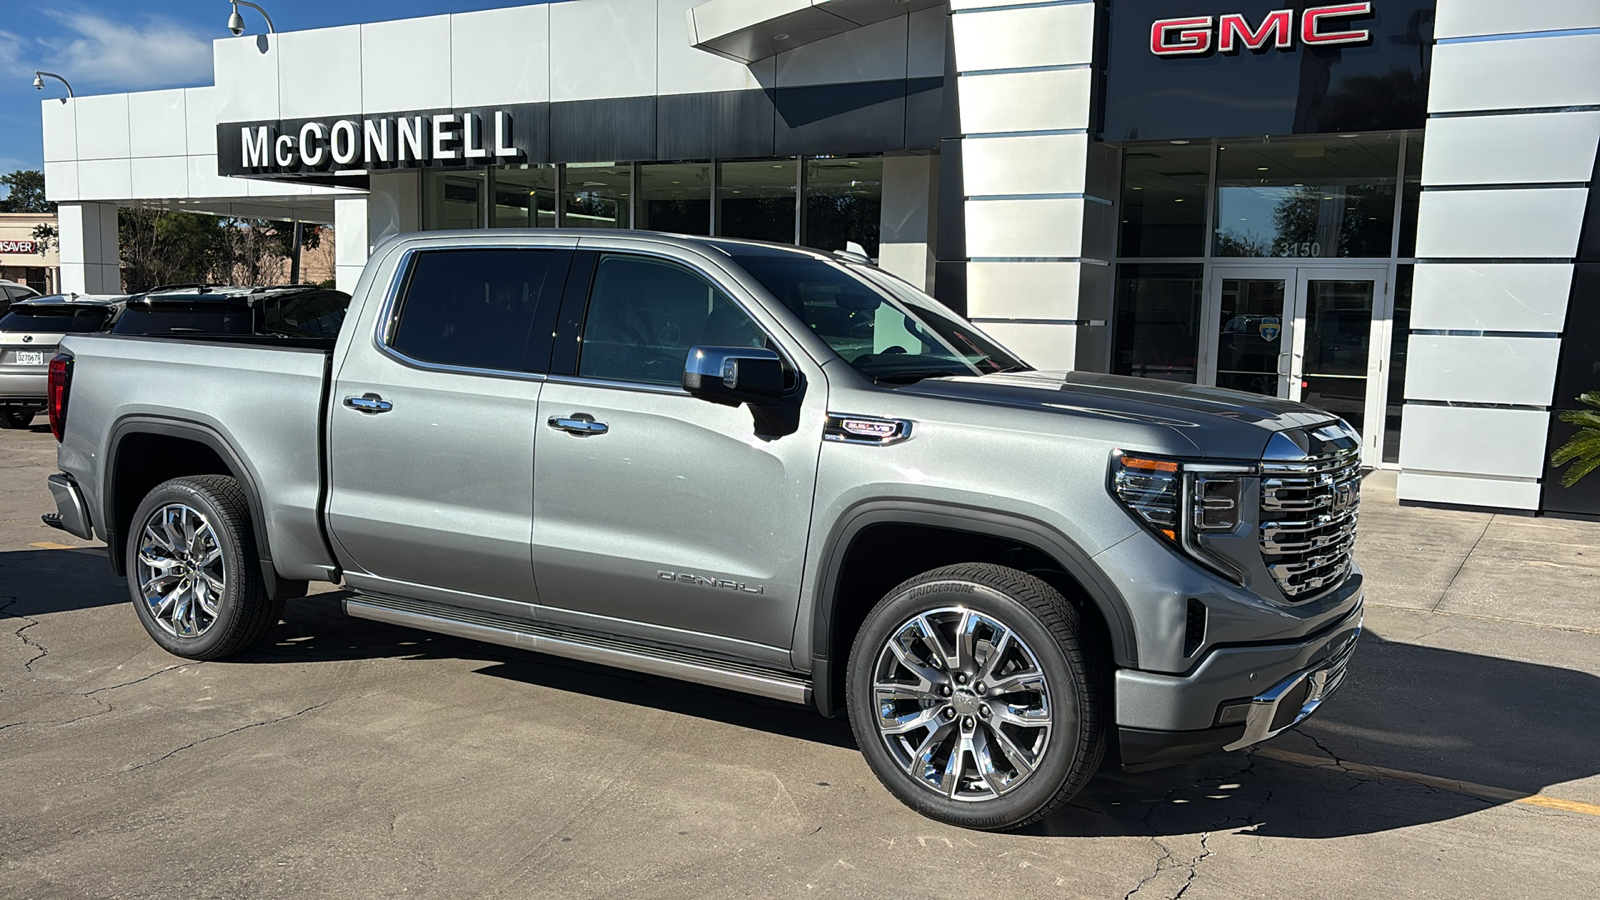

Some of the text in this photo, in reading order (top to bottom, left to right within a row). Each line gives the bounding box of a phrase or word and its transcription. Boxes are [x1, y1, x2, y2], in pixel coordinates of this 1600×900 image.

[1150, 1, 1372, 56] GMC
[241, 110, 519, 168] McCONNELL
[1280, 242, 1321, 257] 3150
[657, 569, 764, 595] DENALI
[908, 583, 976, 600] BRIDGESTONE
